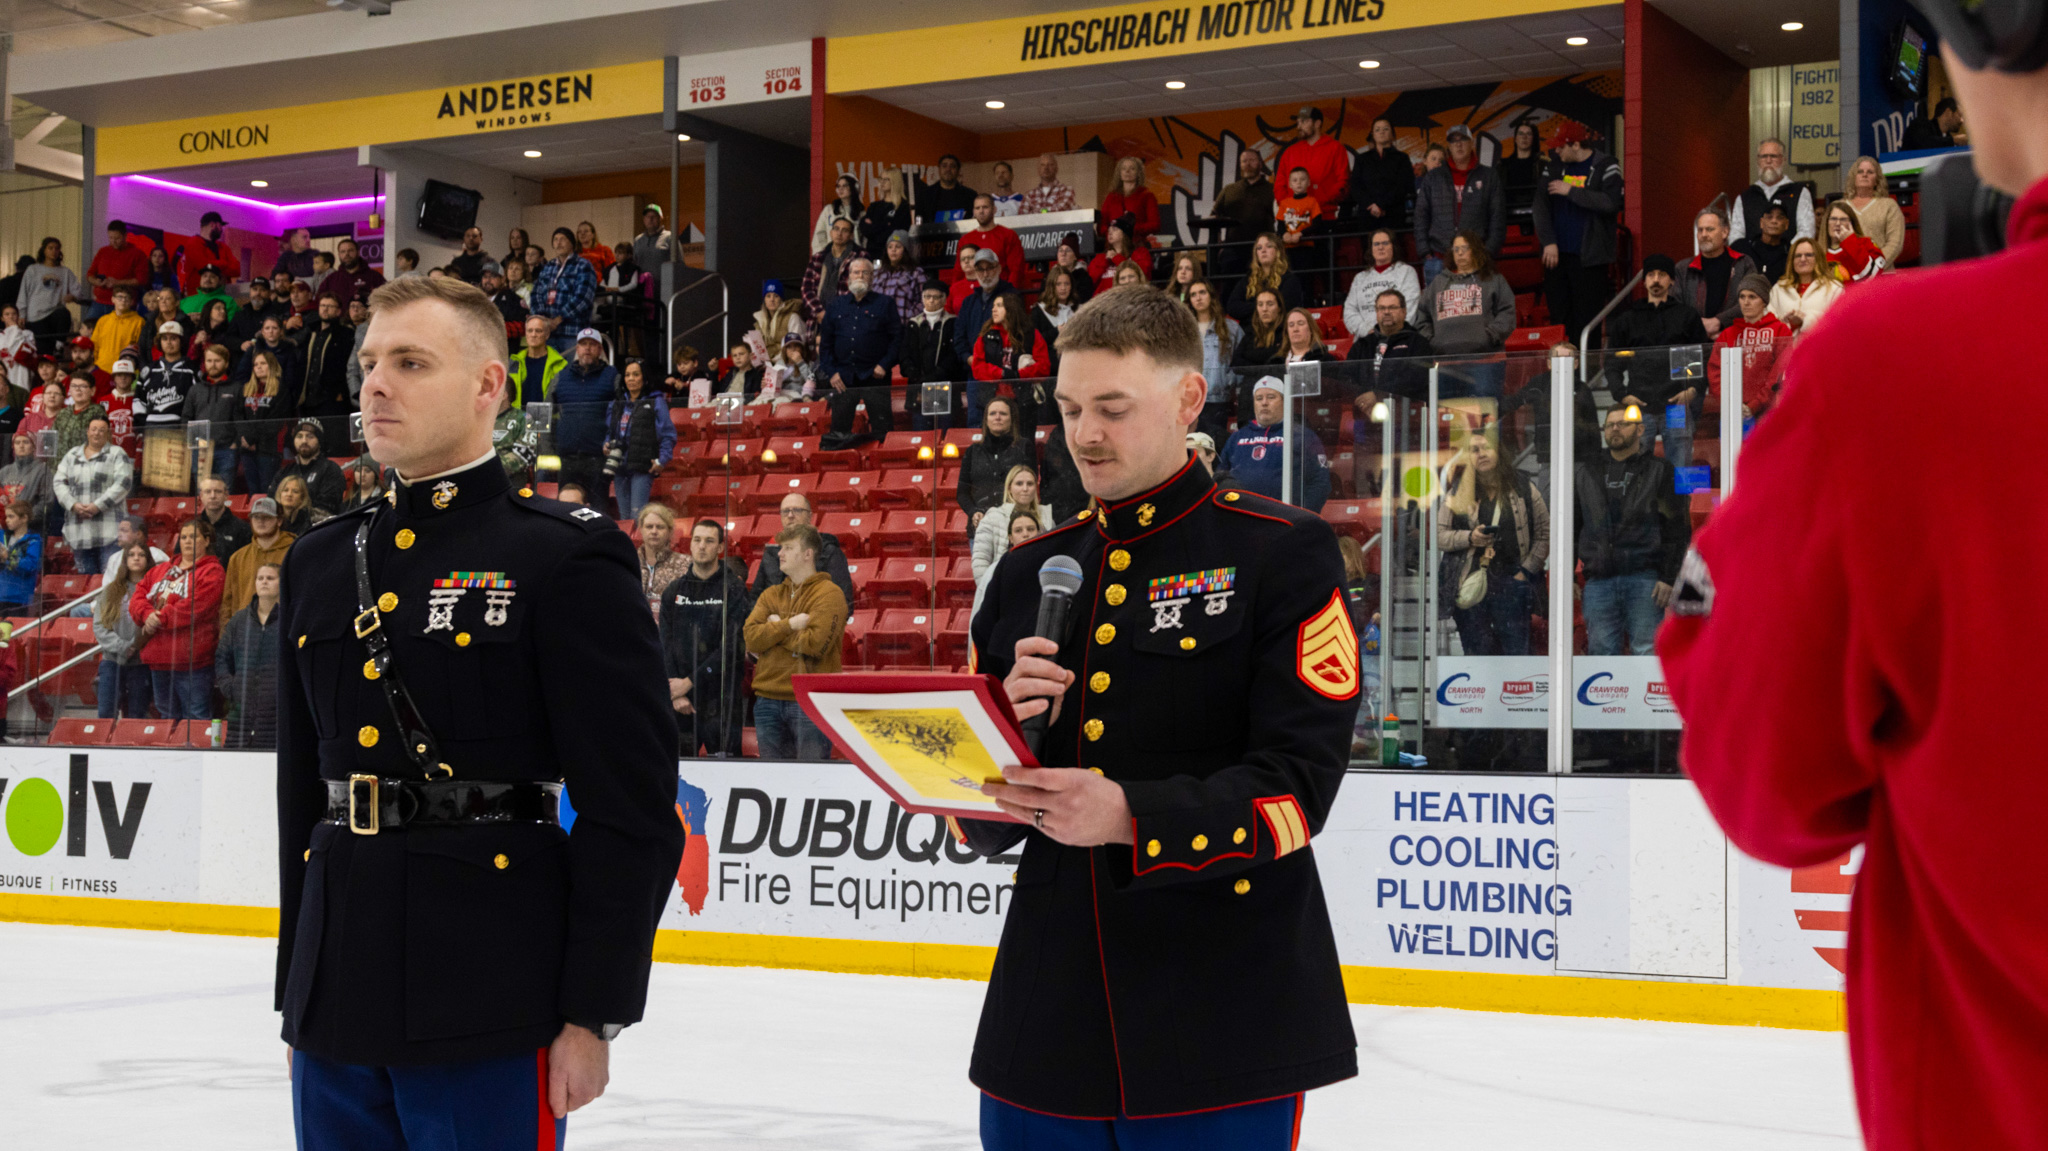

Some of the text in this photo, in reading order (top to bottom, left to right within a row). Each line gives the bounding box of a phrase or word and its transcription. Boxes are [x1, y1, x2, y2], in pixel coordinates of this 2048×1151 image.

[1020, 0, 1385, 61] HIRSCHBACH MOTOR LINES
[691, 76, 725, 88] SECTION
[765, 66, 801, 80] SECTION
[1794, 68, 1838, 85] FIGHTI
[689, 86, 726, 103] 103
[763, 78, 802, 95] 104
[436, 74, 593, 119] ANDERSEN
[1801, 90, 1834, 106] 1982
[475, 112, 552, 130] WINDOWS
[178, 124, 270, 155] CONLON
[1793, 123, 1841, 139] REGUL
[1506, 683, 1530, 693] bryant
[1394, 791, 1555, 825] HEATING
[718, 787, 1022, 866] DUBUQ
[1389, 834, 1560, 871] COOLING
[62, 878, 118, 893] FITNESS
[718, 861, 791, 905] Fire
[1377, 877, 1572, 916] PLUMBING
[1387, 922, 1559, 961] WELDING
